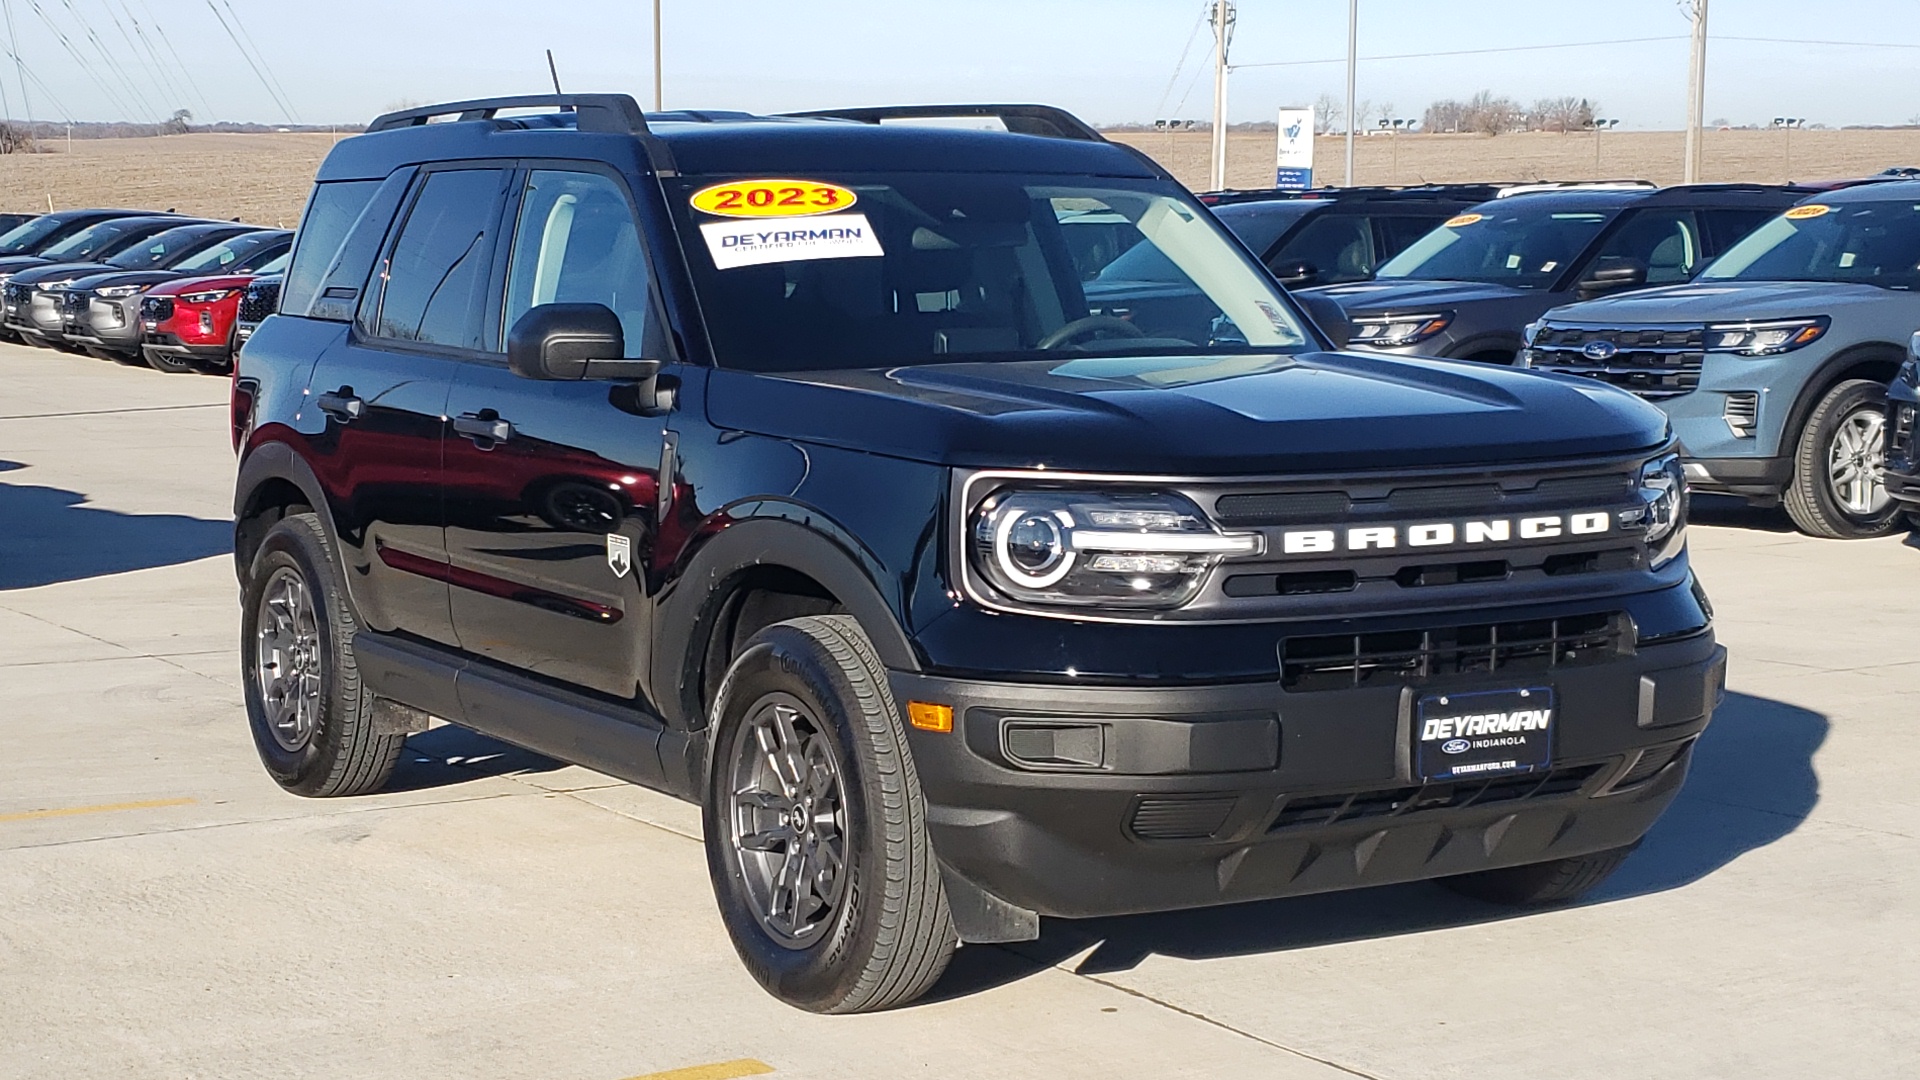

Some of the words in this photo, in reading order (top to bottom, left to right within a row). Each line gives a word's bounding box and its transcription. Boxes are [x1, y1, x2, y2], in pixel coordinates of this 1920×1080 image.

[714, 187, 838, 210] 2023
[722, 228, 861, 248] DEYARMAN
[1284, 512, 1609, 553] BRONCO
[1421, 709, 1551, 741] DEYARMAN
[1472, 736, 1526, 749] INDIANOLA
